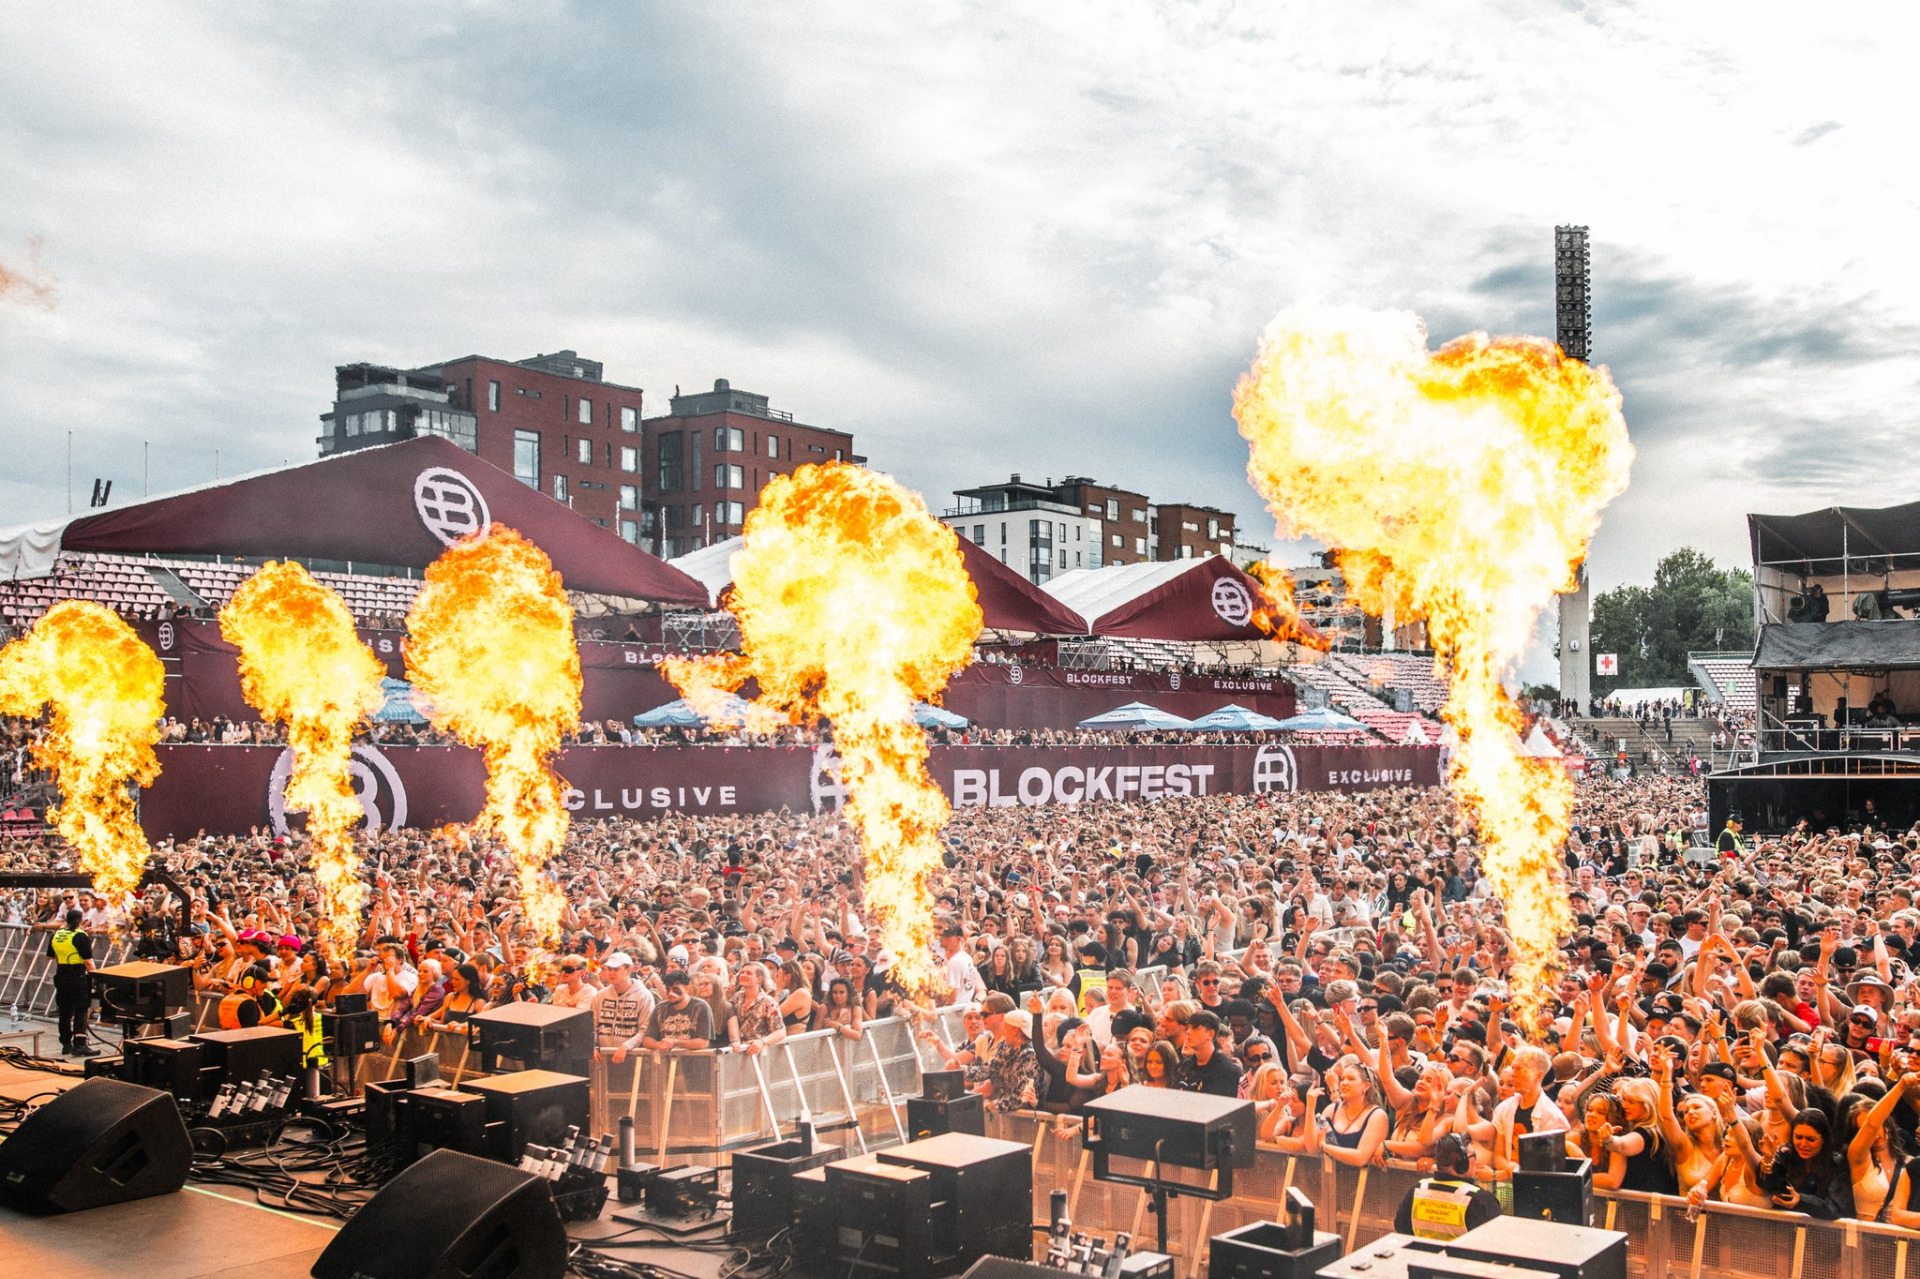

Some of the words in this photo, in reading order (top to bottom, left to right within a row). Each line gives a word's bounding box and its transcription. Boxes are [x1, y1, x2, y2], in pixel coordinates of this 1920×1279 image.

[1066, 673, 1133, 685] BLOCKFEST
[1213, 680, 1273, 691] EXCLUSIVE
[1328, 768, 1413, 785] EXCLUSIVE
[952, 764, 1215, 810] BLOCKFEST
[561, 785, 737, 811] CLUSIVE
